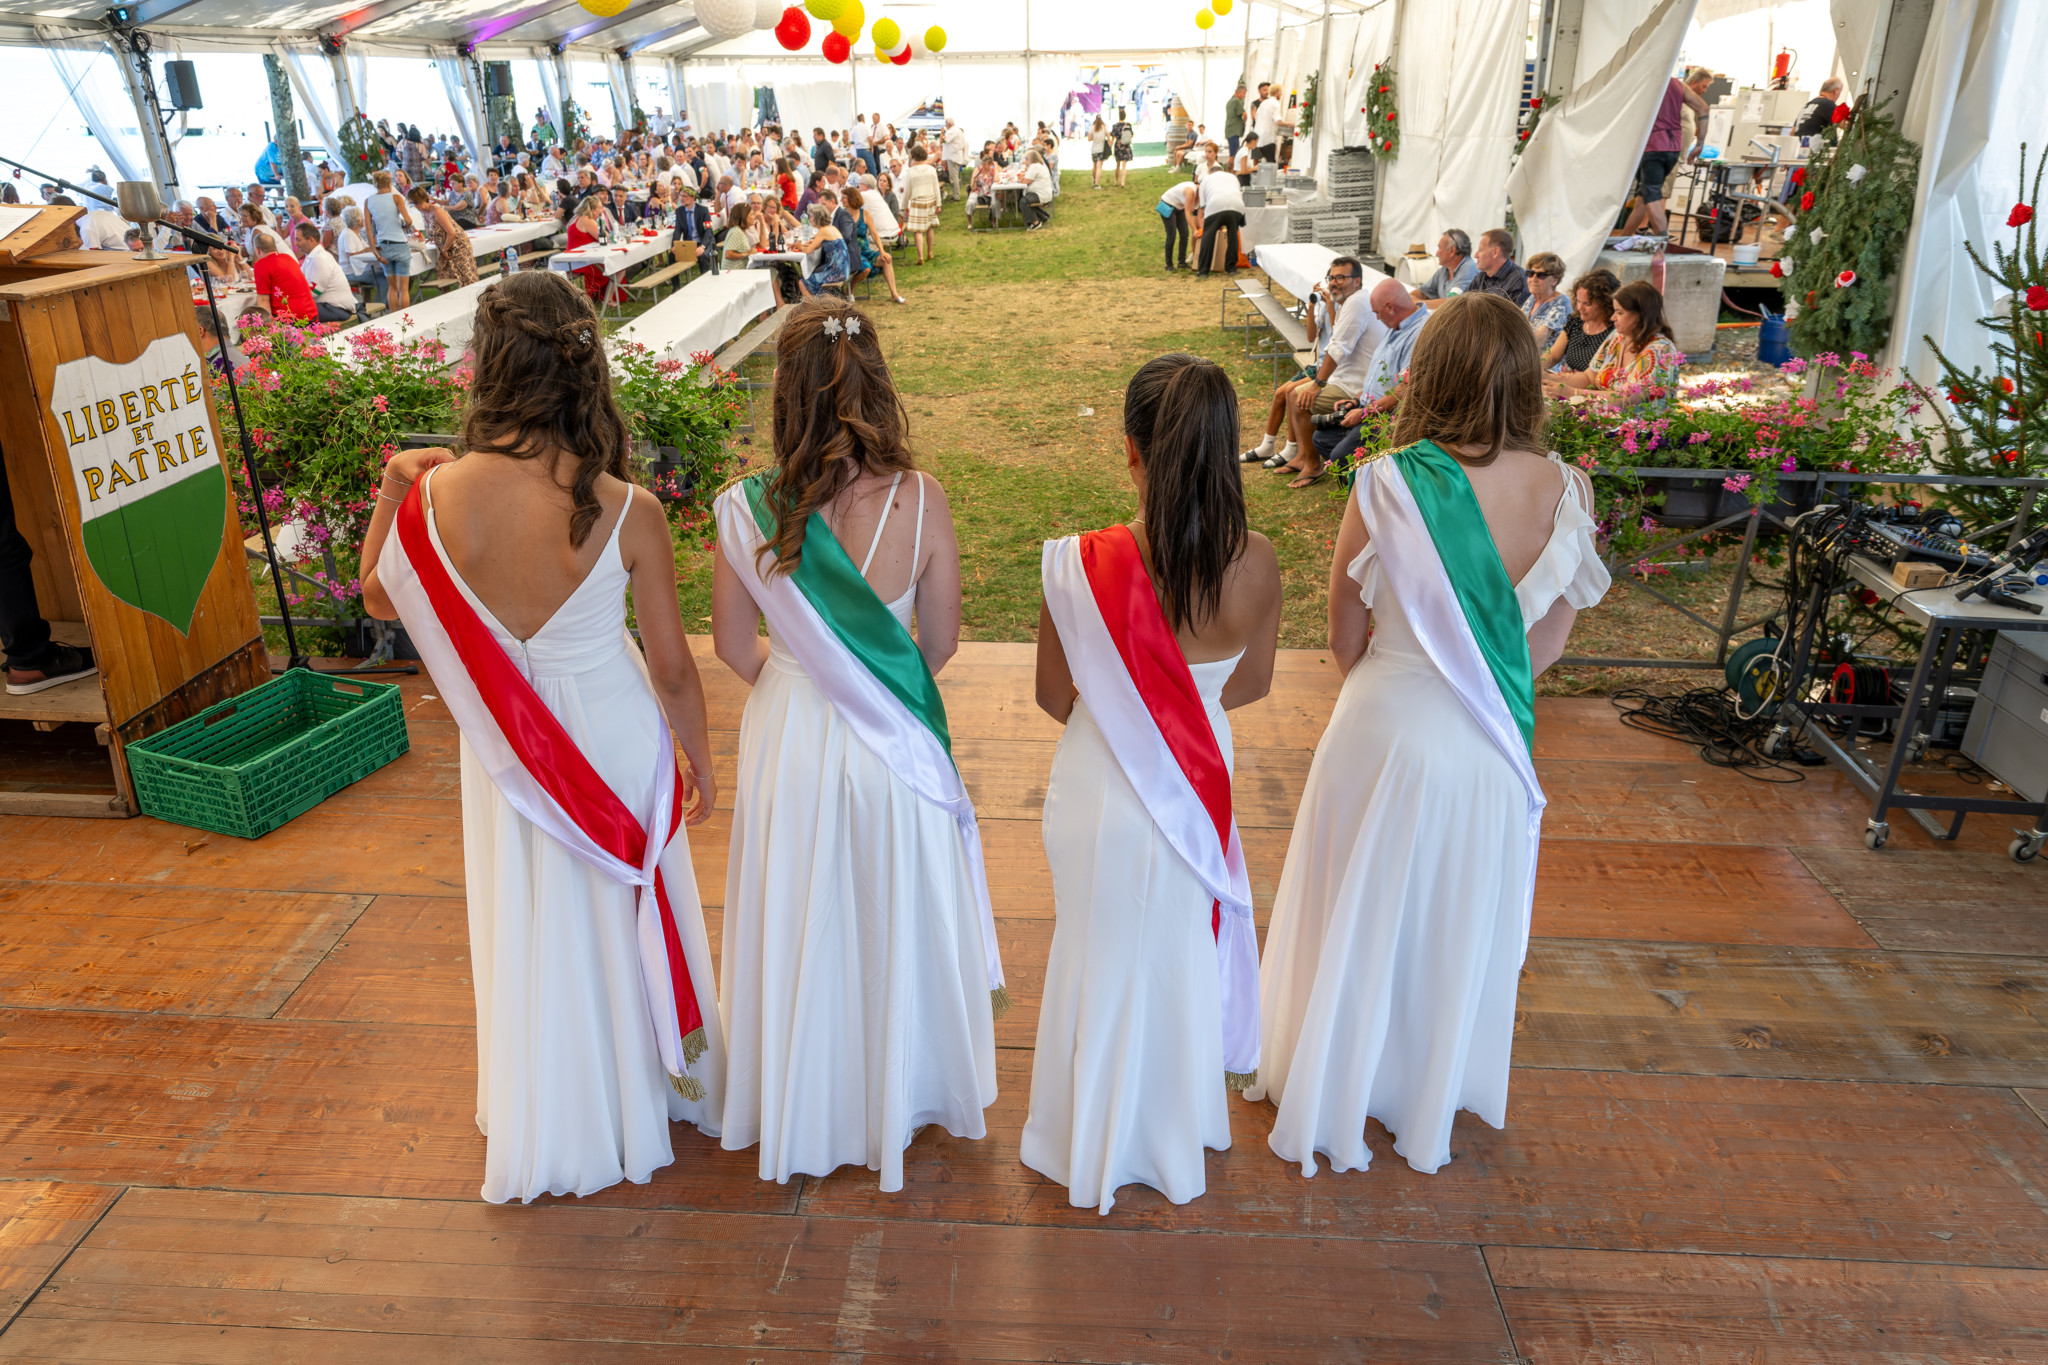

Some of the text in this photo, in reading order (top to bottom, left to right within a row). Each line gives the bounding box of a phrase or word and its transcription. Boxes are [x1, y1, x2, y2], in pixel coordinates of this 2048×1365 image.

[63, 364, 202, 447] LIBERTÉ
[132, 422, 154, 446] ET
[83, 426, 208, 502] PATRIE
